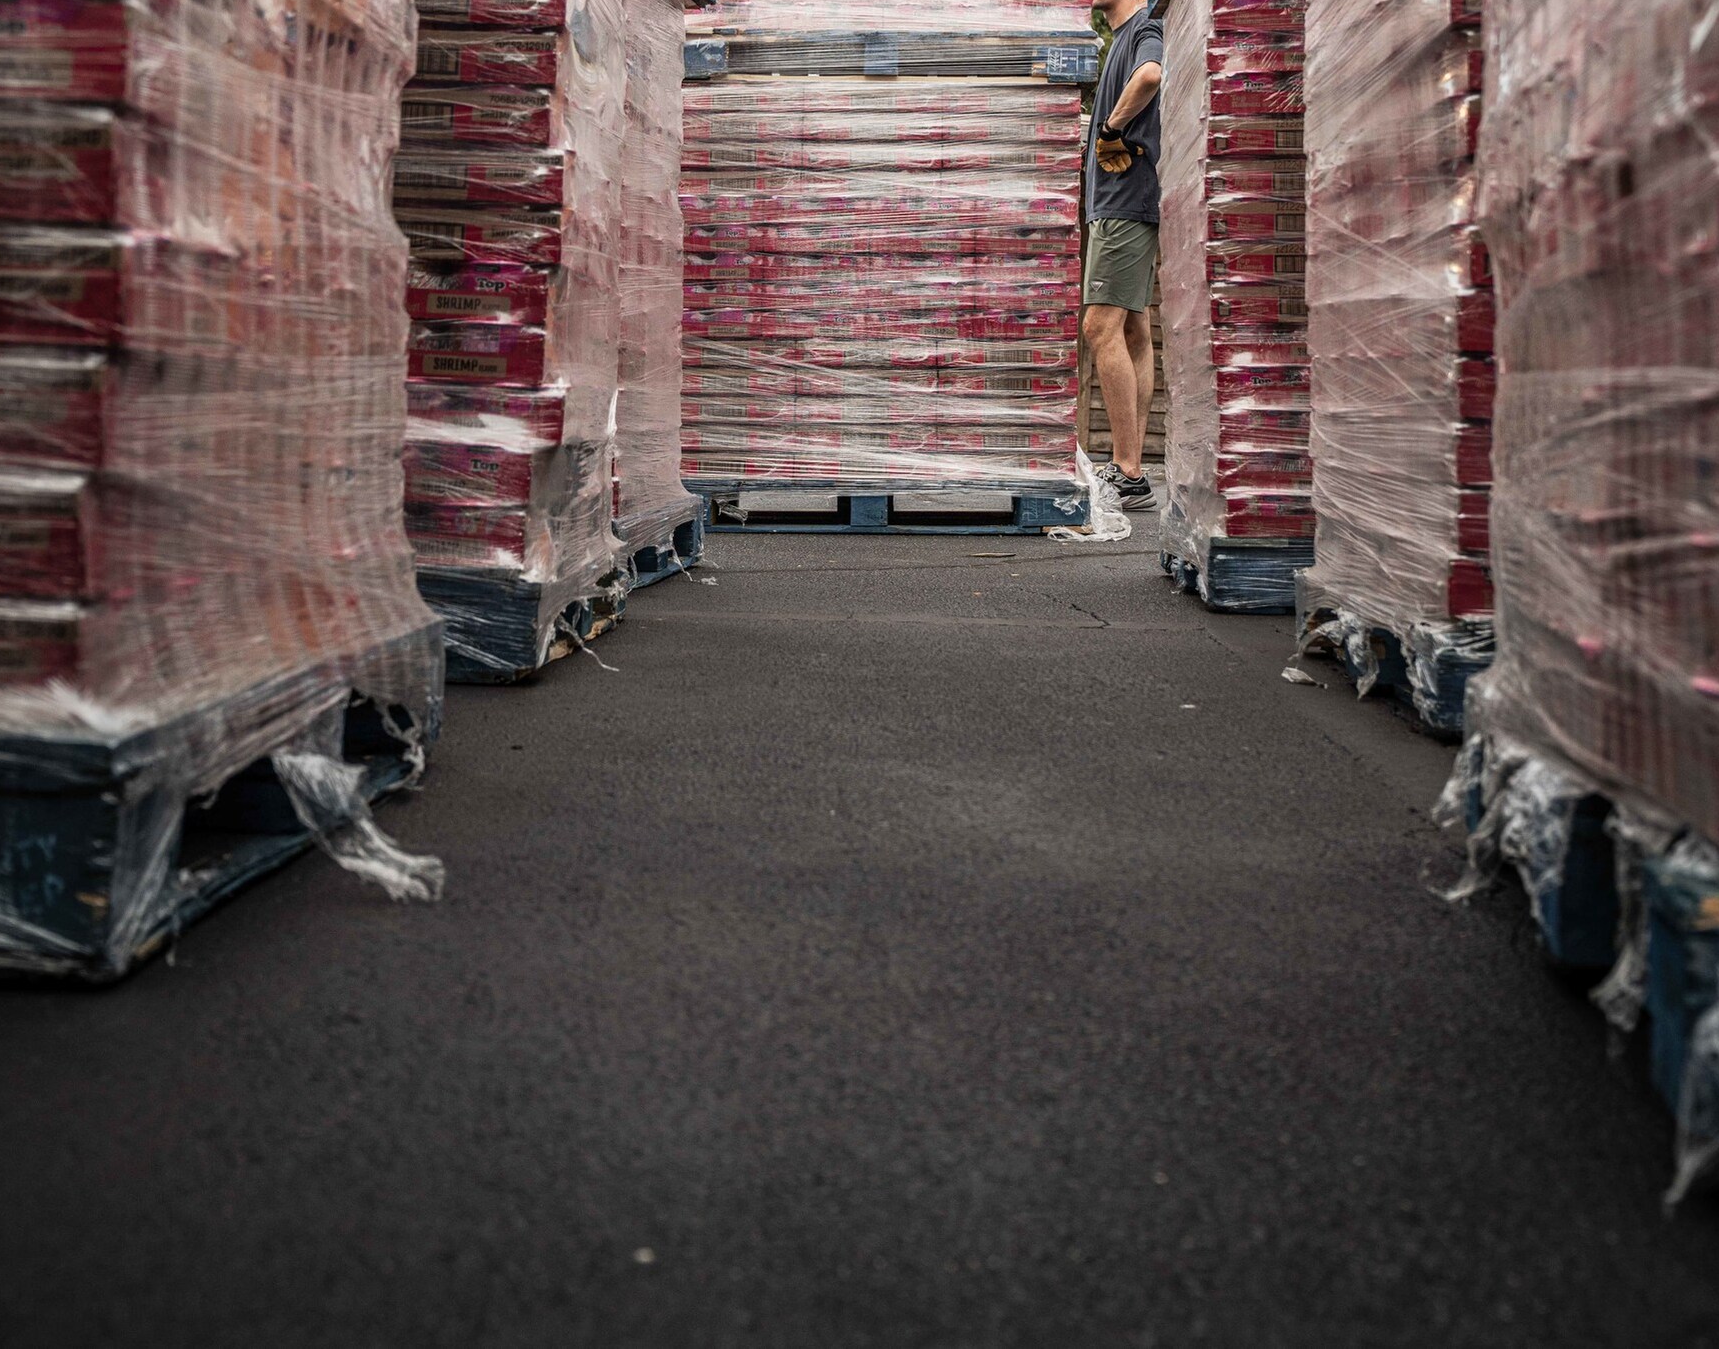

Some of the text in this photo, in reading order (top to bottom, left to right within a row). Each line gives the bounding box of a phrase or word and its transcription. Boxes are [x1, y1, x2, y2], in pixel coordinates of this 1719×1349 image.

[1244, 80, 1263, 90] Top
[1236, 258, 1250, 266] Top
[476, 278, 505, 292] Top
[436, 296, 481, 310] SHRIMP
[433, 356, 479, 372] SHRIMP
[471, 459, 499, 472] Top
